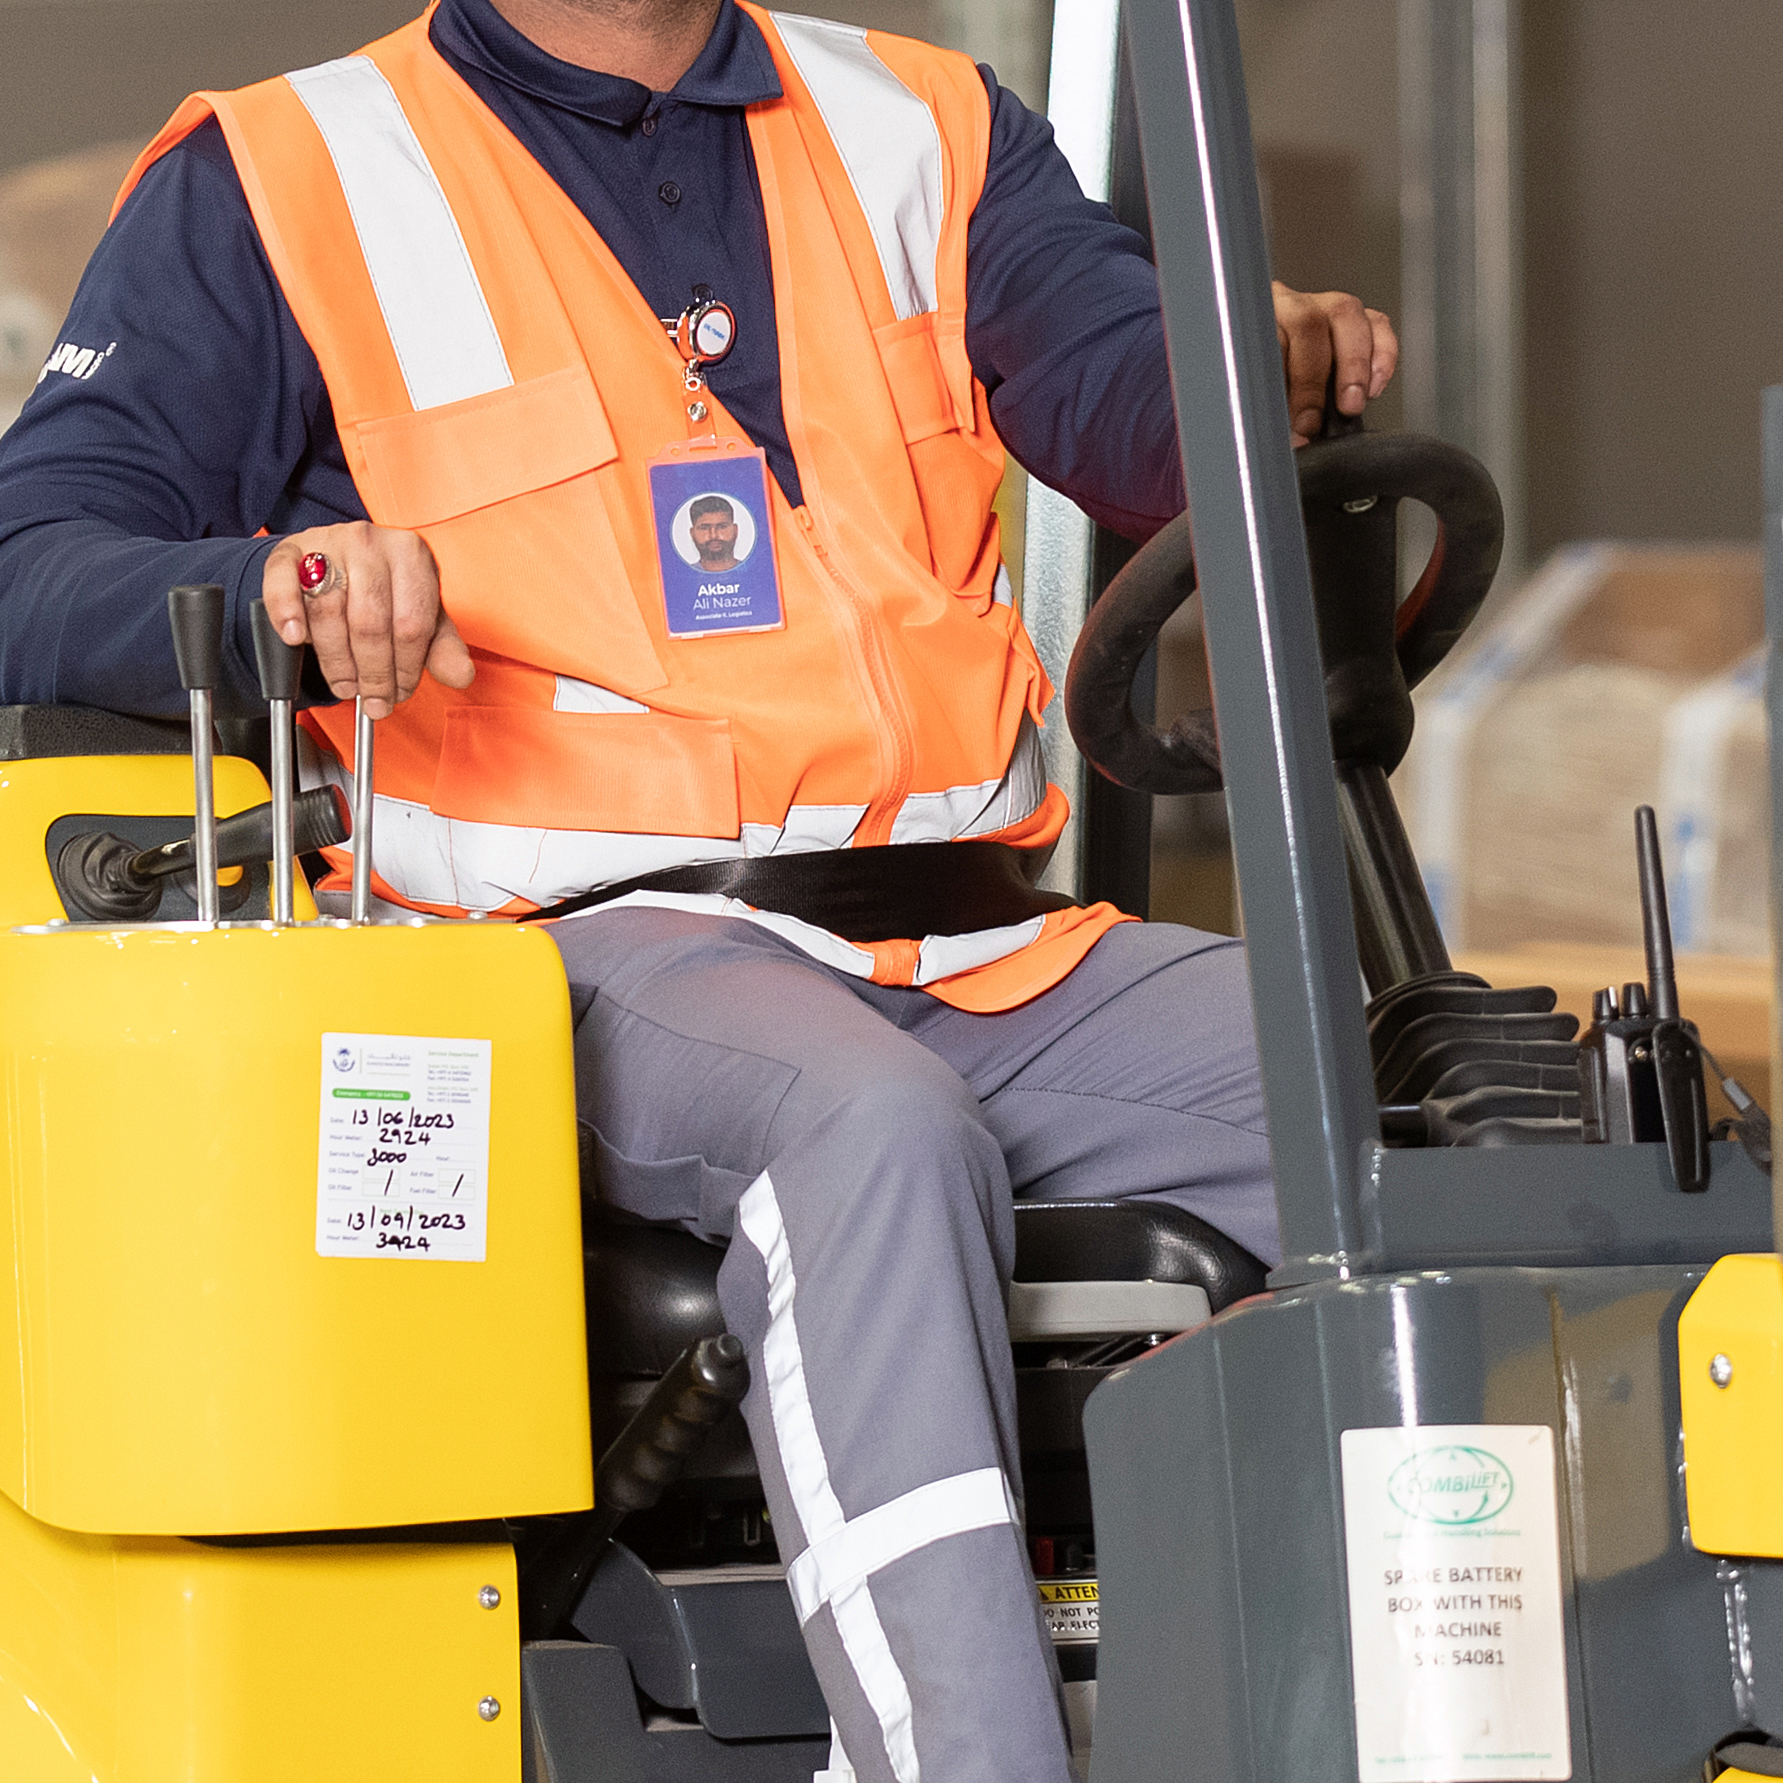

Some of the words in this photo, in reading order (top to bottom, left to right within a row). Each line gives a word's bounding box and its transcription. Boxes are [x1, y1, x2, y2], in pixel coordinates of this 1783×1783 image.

[698, 583, 740, 596] Akbar
[693, 597, 709, 610] Ali
[713, 597, 751, 608] Nazer
[379, 1128, 431, 1146] 2924
[1384, 1568, 1442, 1585] SPE
[1449, 1567, 1522, 1582] BATTERY
[1434, 1595, 1481, 1610] WITH
[1488, 1594, 1522, 1611] THIS
[1060, 1607, 1081, 1617] NOT
[1452, 1649, 1505, 1665] 54081
